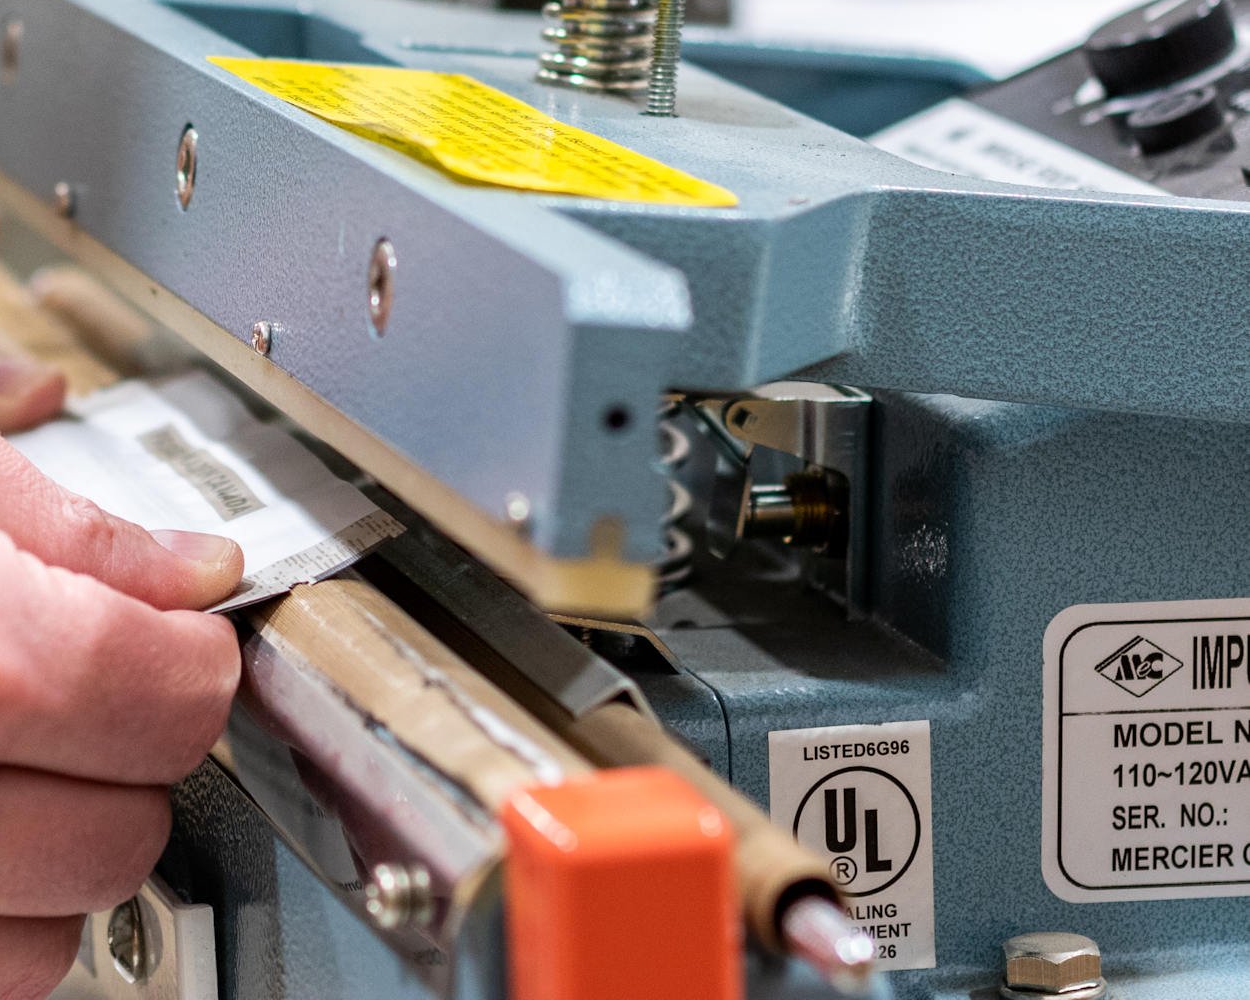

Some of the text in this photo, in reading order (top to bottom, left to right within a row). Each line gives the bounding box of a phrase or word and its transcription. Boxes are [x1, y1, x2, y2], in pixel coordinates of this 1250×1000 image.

[1192, 634, 1250, 690] IMP
[1113, 721, 1223, 748] MODEL
[803, 740, 910, 761] LISTED6G96
[1112, 802, 1228, 830] SER. NO.:
[824, 787, 892, 873] UL
[1111, 843, 1234, 872] MERCIER
[846, 903, 898, 921] ALING
[878, 944, 897, 959] 26
